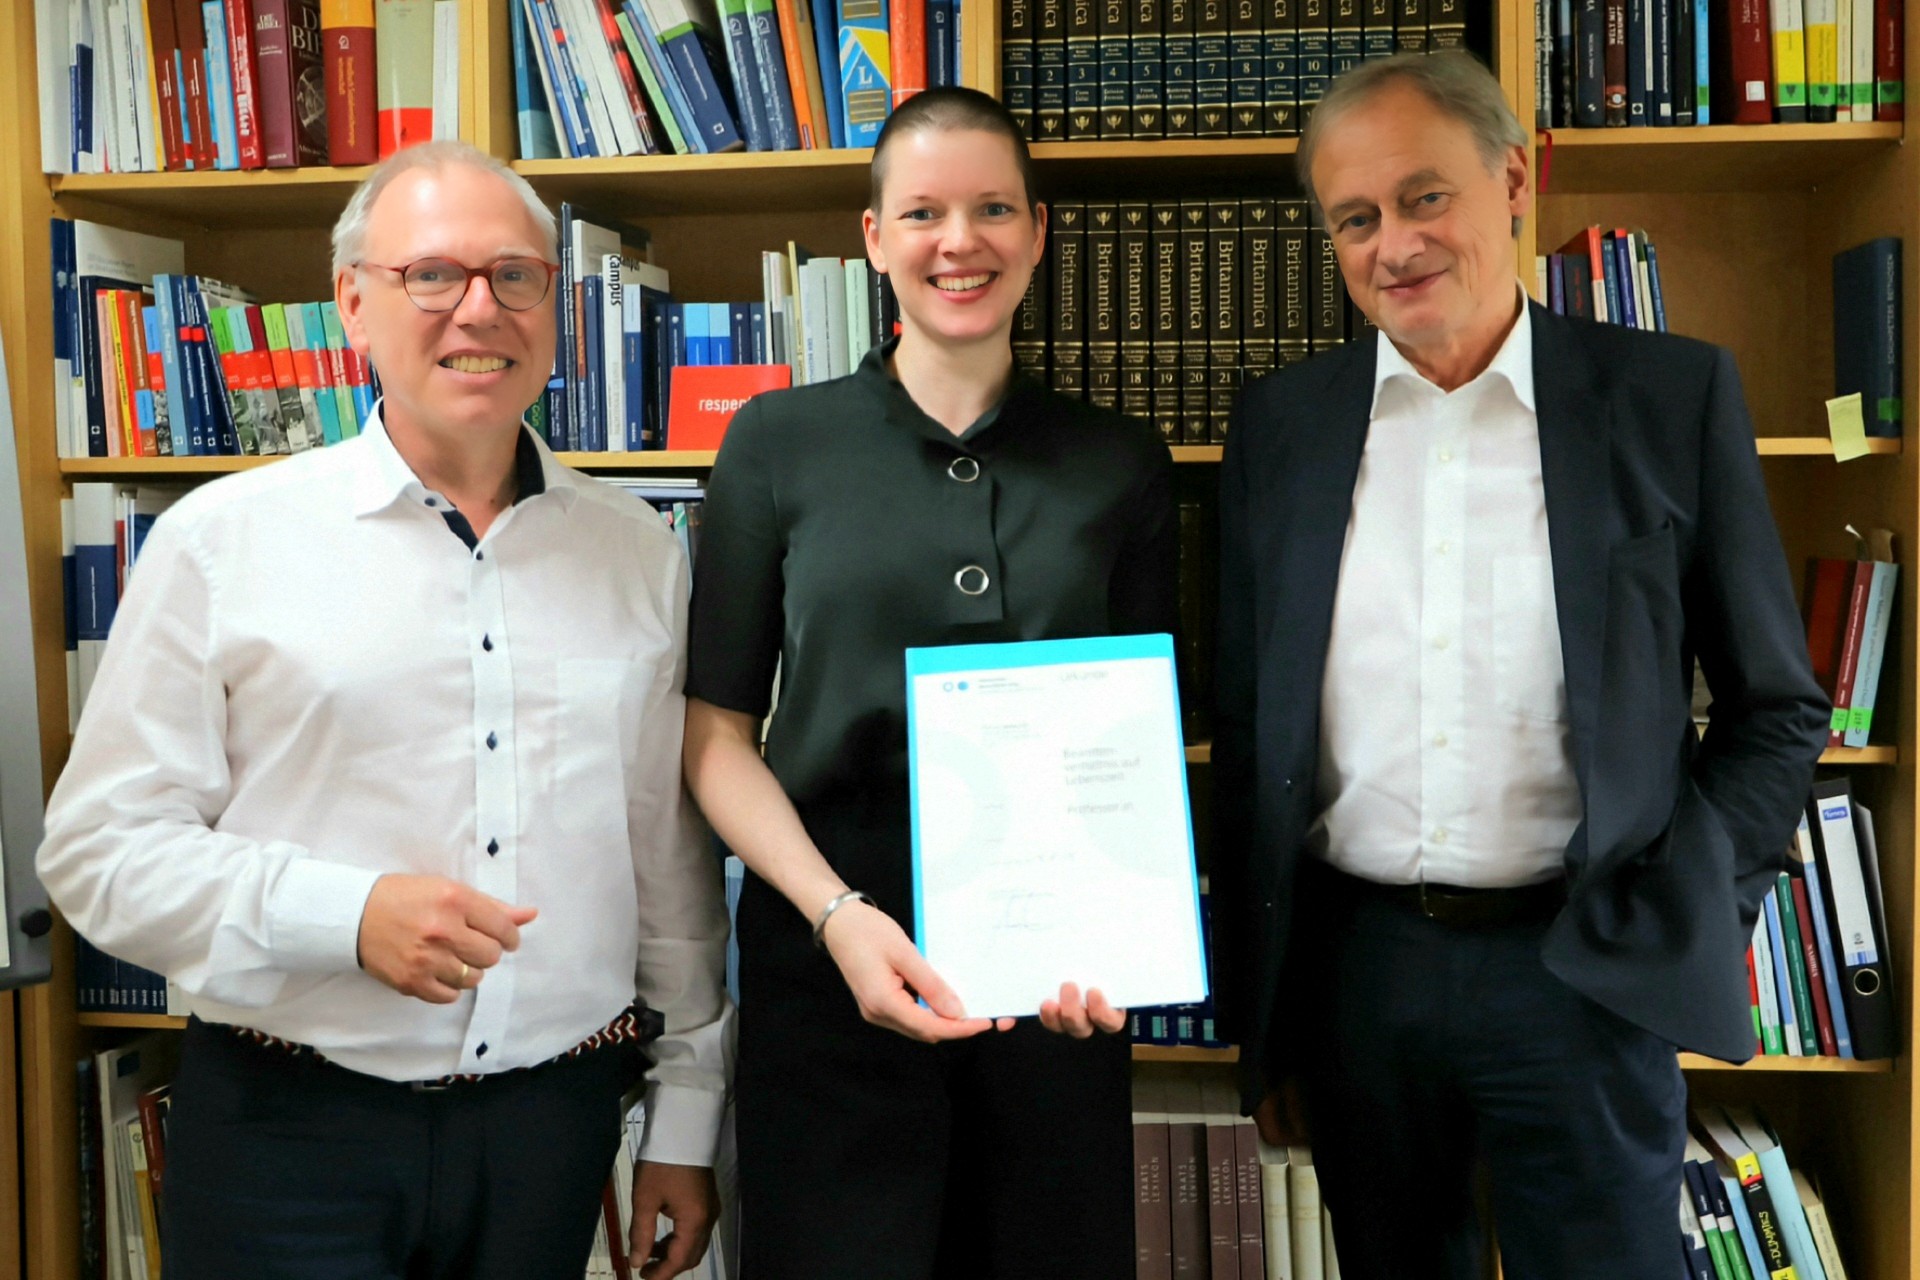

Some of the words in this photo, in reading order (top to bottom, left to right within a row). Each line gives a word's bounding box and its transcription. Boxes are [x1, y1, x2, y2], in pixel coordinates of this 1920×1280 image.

[858, 66, 873, 85] L
[1014, 71, 1020, 81] 1
[1047, 71, 1054, 81] 2
[1078, 68, 1086, 79] 3
[1108, 67, 1117, 77] 4
[1143, 65, 1151, 76] 5
[1174, 65, 1182, 76] 6
[1208, 63, 1216, 74] 7
[1242, 63, 1250, 73] 8
[1276, 62, 1284, 72] 9
[1307, 61, 1320, 71] 10
[1061, 243, 1077, 331] Britannica
[1097, 243, 1113, 331] Britannica
[1128, 242, 1144, 331] Britannica
[1159, 242, 1175, 331] Britannica
[1189, 241, 1205, 330] Britannica
[1219, 239, 1235, 330] Britannica
[1253, 238, 1268, 328] Britannica
[1287, 238, 1302, 328] Britannica
[1322, 238, 1338, 328] Britannica
[1060, 373, 1073, 385] 16
[1099, 373, 1110, 385] 17
[1130, 372, 1142, 384] 18
[1160, 372, 1173, 384] 19
[1189, 372, 1203, 384] 20
[1219, 372, 1231, 384] 21
[1141, 1164, 1149, 1203] STAATS
[1151, 1156, 1160, 1203] LEXIKON
[1178, 1164, 1187, 1203] STAATS
[1189, 1156, 1198, 1203] LEXIKON
[1211, 1166, 1221, 1205] STAATS
[1222, 1158, 1232, 1205] LEXIKON
[1238, 1164, 1248, 1203] STAATS
[1248, 1156, 1258, 1203] LEXIKON
[1758, 1211, 1782, 1259] DUMMIES
